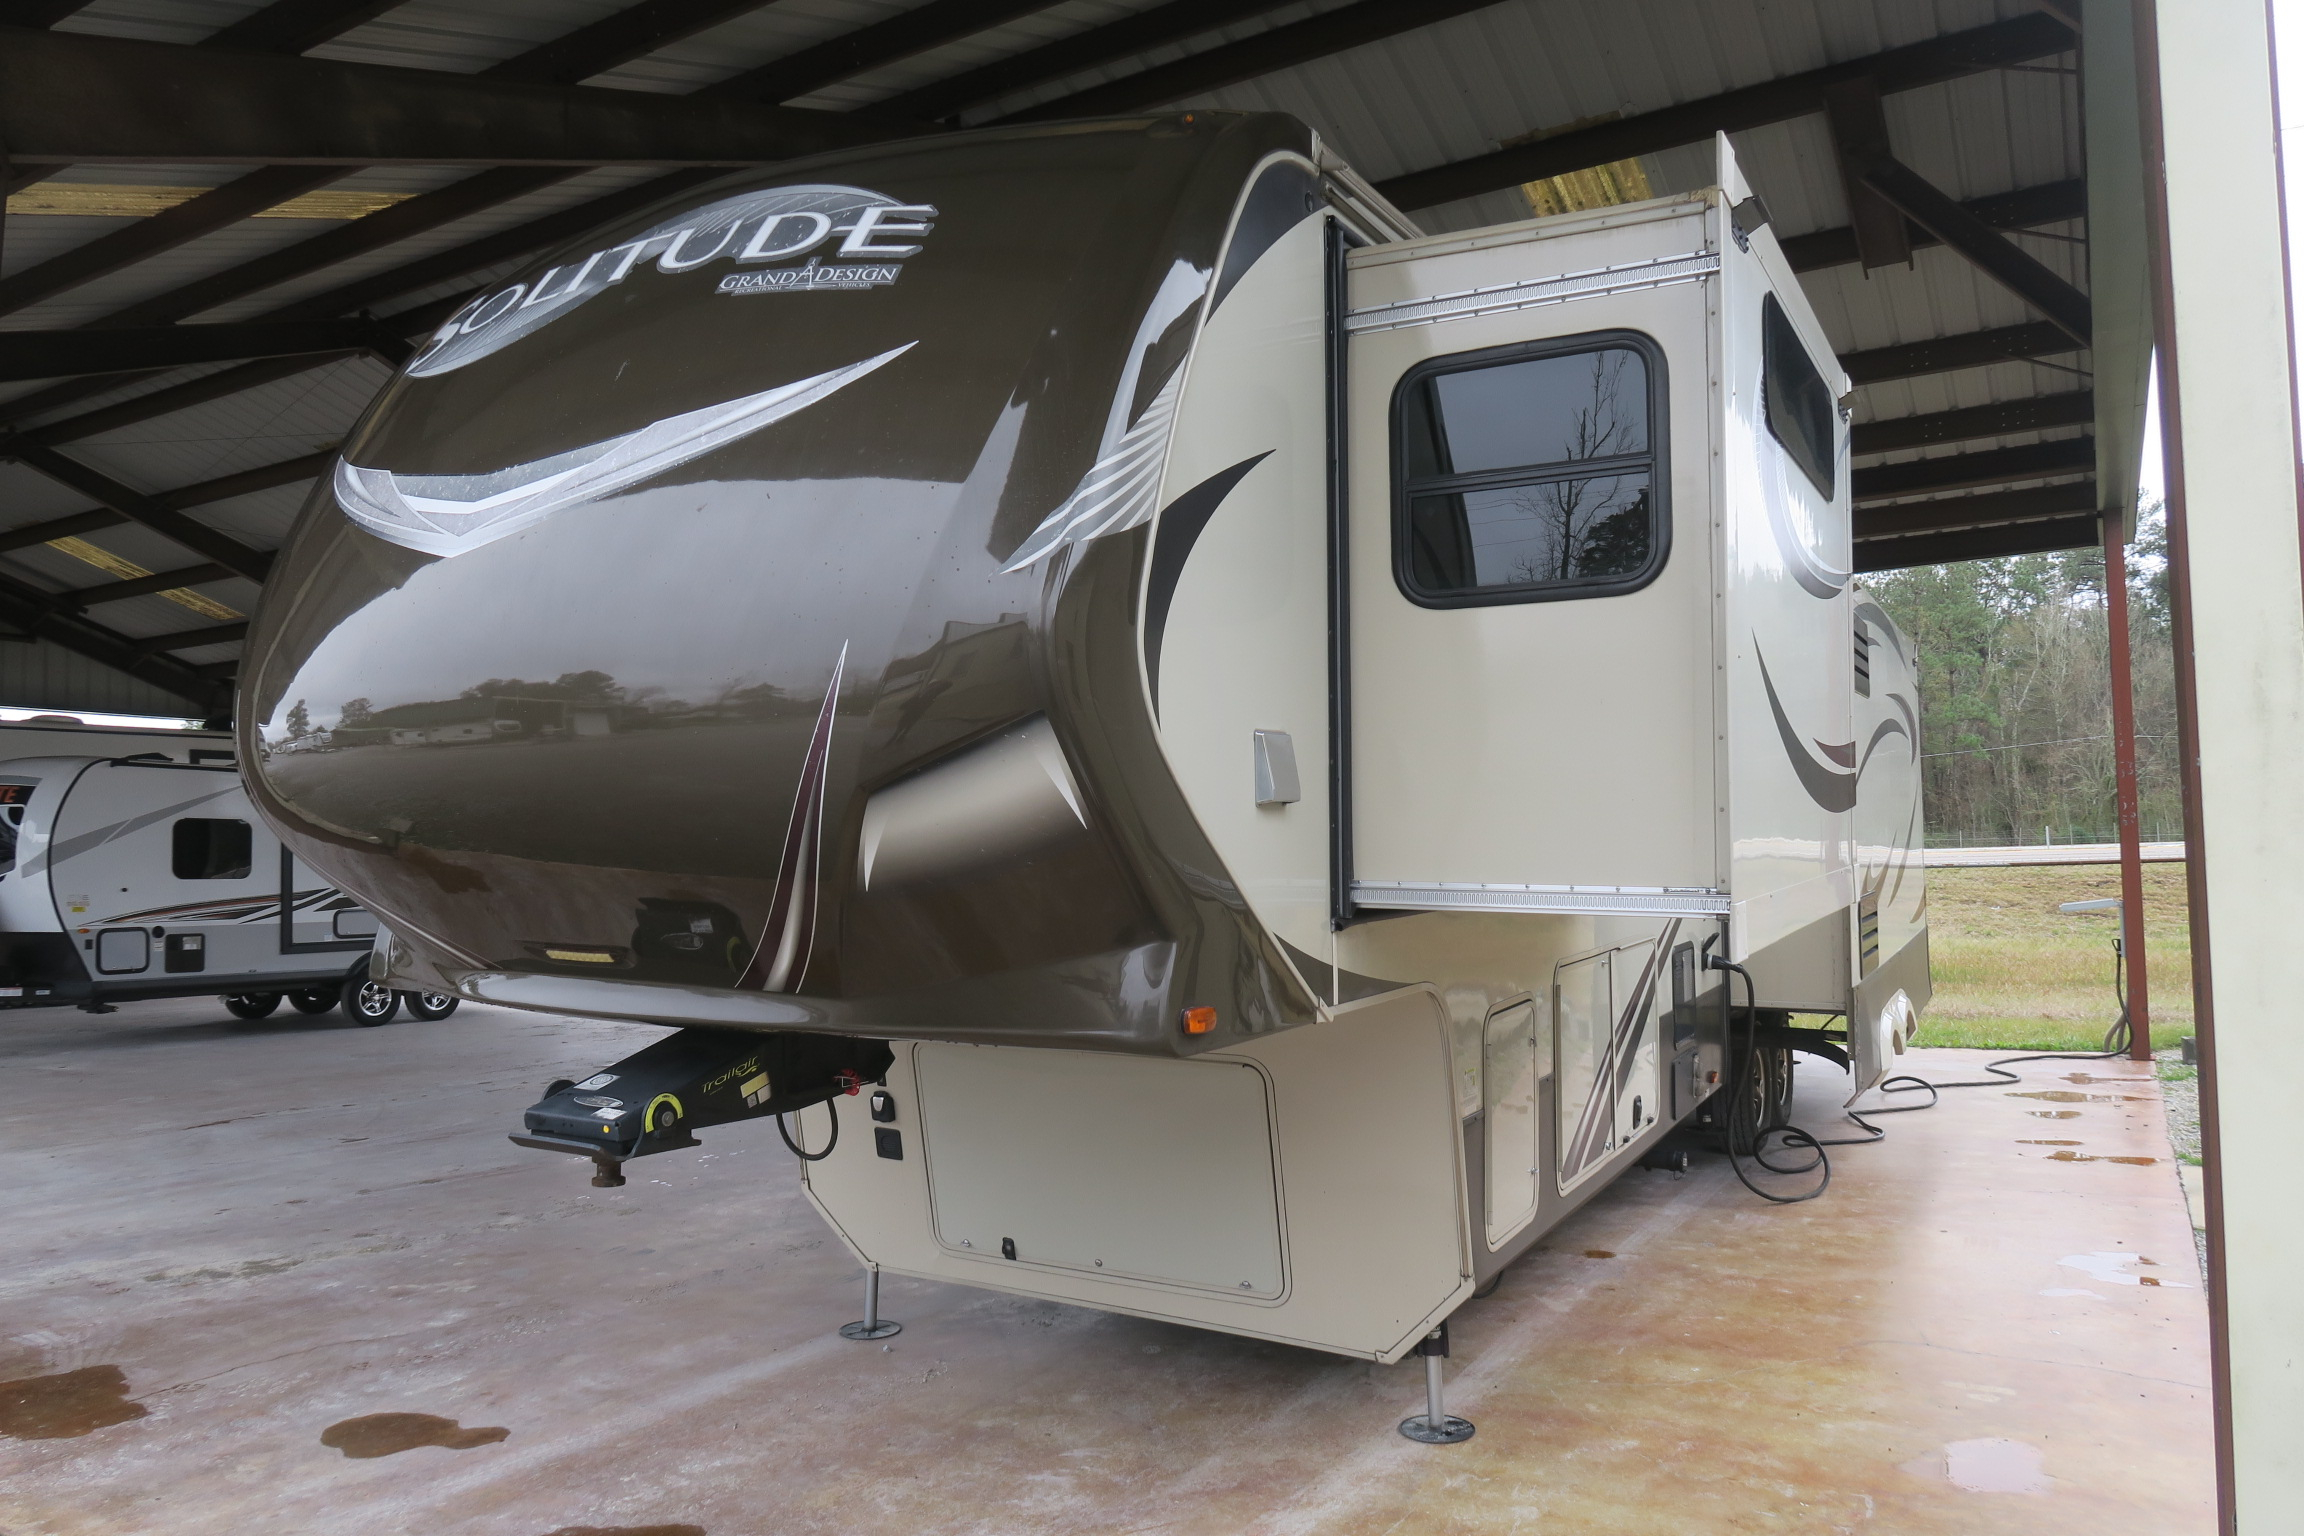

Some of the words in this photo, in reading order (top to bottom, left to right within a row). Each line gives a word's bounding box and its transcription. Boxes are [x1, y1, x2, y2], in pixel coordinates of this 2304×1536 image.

[407, 203, 937, 373] SOLITUDE
[719, 271, 797, 289] GRAND
[814, 267, 897, 282] DESIGN
[734, 285, 783, 294] RECREATIONAL
